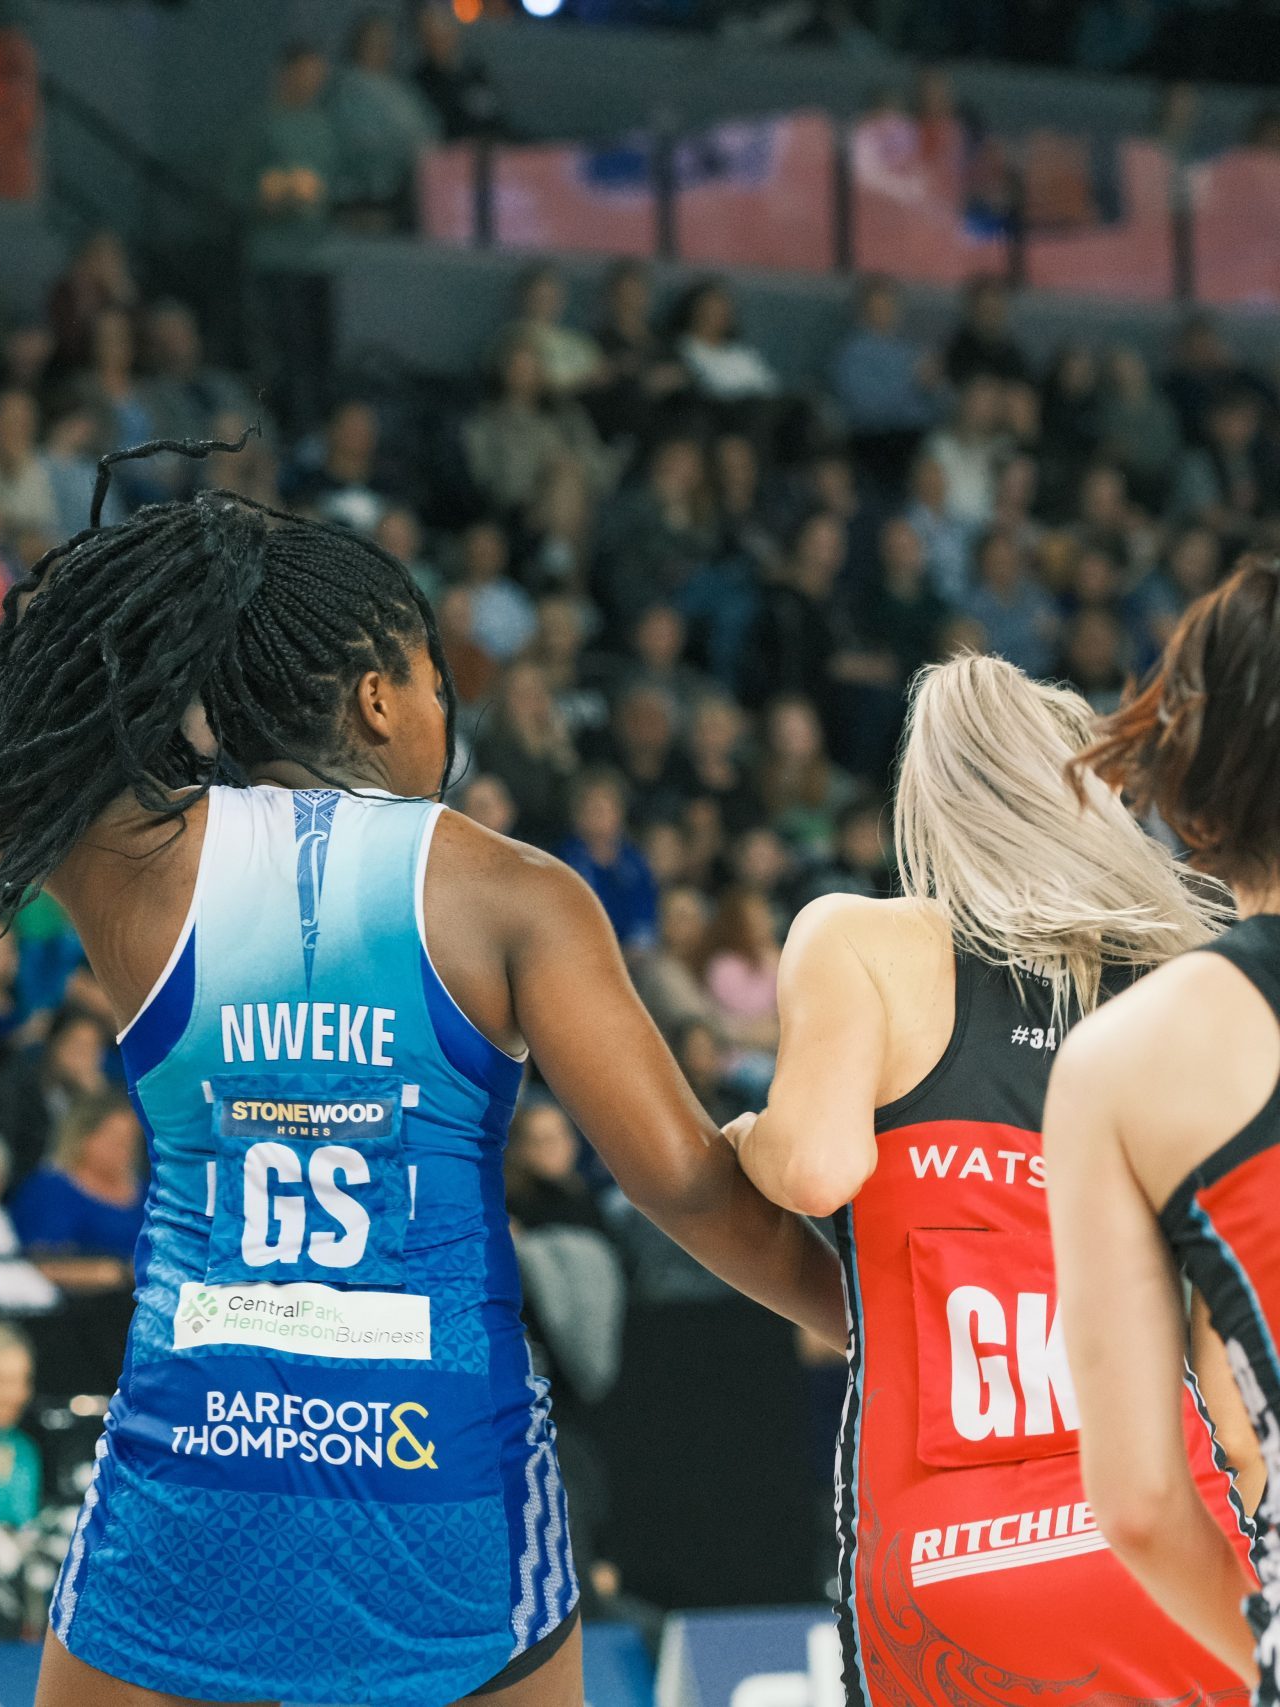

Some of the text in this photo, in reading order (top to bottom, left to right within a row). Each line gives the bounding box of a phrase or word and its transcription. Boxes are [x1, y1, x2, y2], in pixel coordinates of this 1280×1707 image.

[220, 1002, 396, 1067] NWEKE
[1011, 1024, 1057, 1051] #34
[231, 1101, 384, 1123] STONEWOOD
[276, 1125, 332, 1137] HOMES
[908, 1144, 1047, 1189] WATS
[241, 1142, 371, 1268] GS
[223, 1312, 425, 1344] HendersonBusiness
[227, 1295, 344, 1324] CentralPark
[946, 1285, 1081, 1442] GK
[171, 1423, 384, 1469] THOMPSON
[206, 1390, 439, 1470] BARFOOT &
